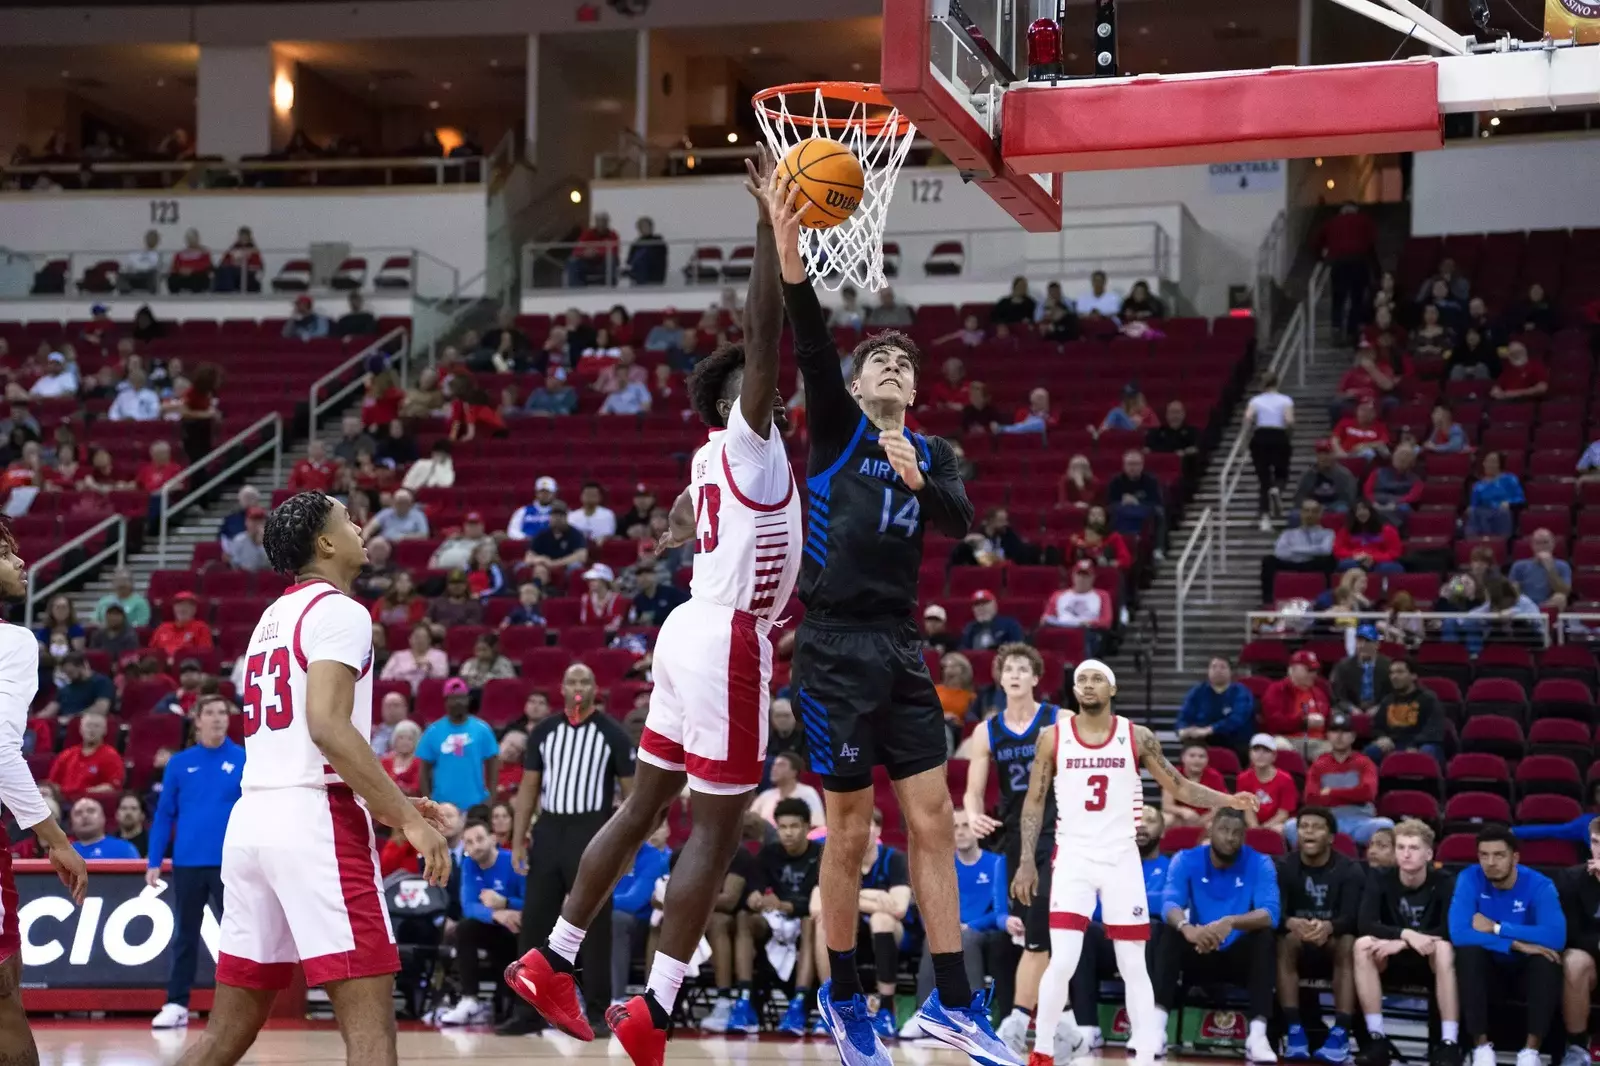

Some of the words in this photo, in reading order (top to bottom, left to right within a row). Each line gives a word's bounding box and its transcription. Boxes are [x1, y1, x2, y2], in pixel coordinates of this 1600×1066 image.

[1563, 0, 1591, 15] SINO
[912, 179, 943, 203] 122
[150, 200, 180, 224] 123
[859, 457, 891, 480] AIR
[877, 487, 920, 537] 14
[243, 645, 294, 738] 53
[839, 742, 860, 763] AF
[997, 748, 1013, 761] AIR
[1065, 757, 1126, 769] BULLDOGS
[1008, 763, 1035, 791] 2
[1084, 775, 1109, 812] 3
